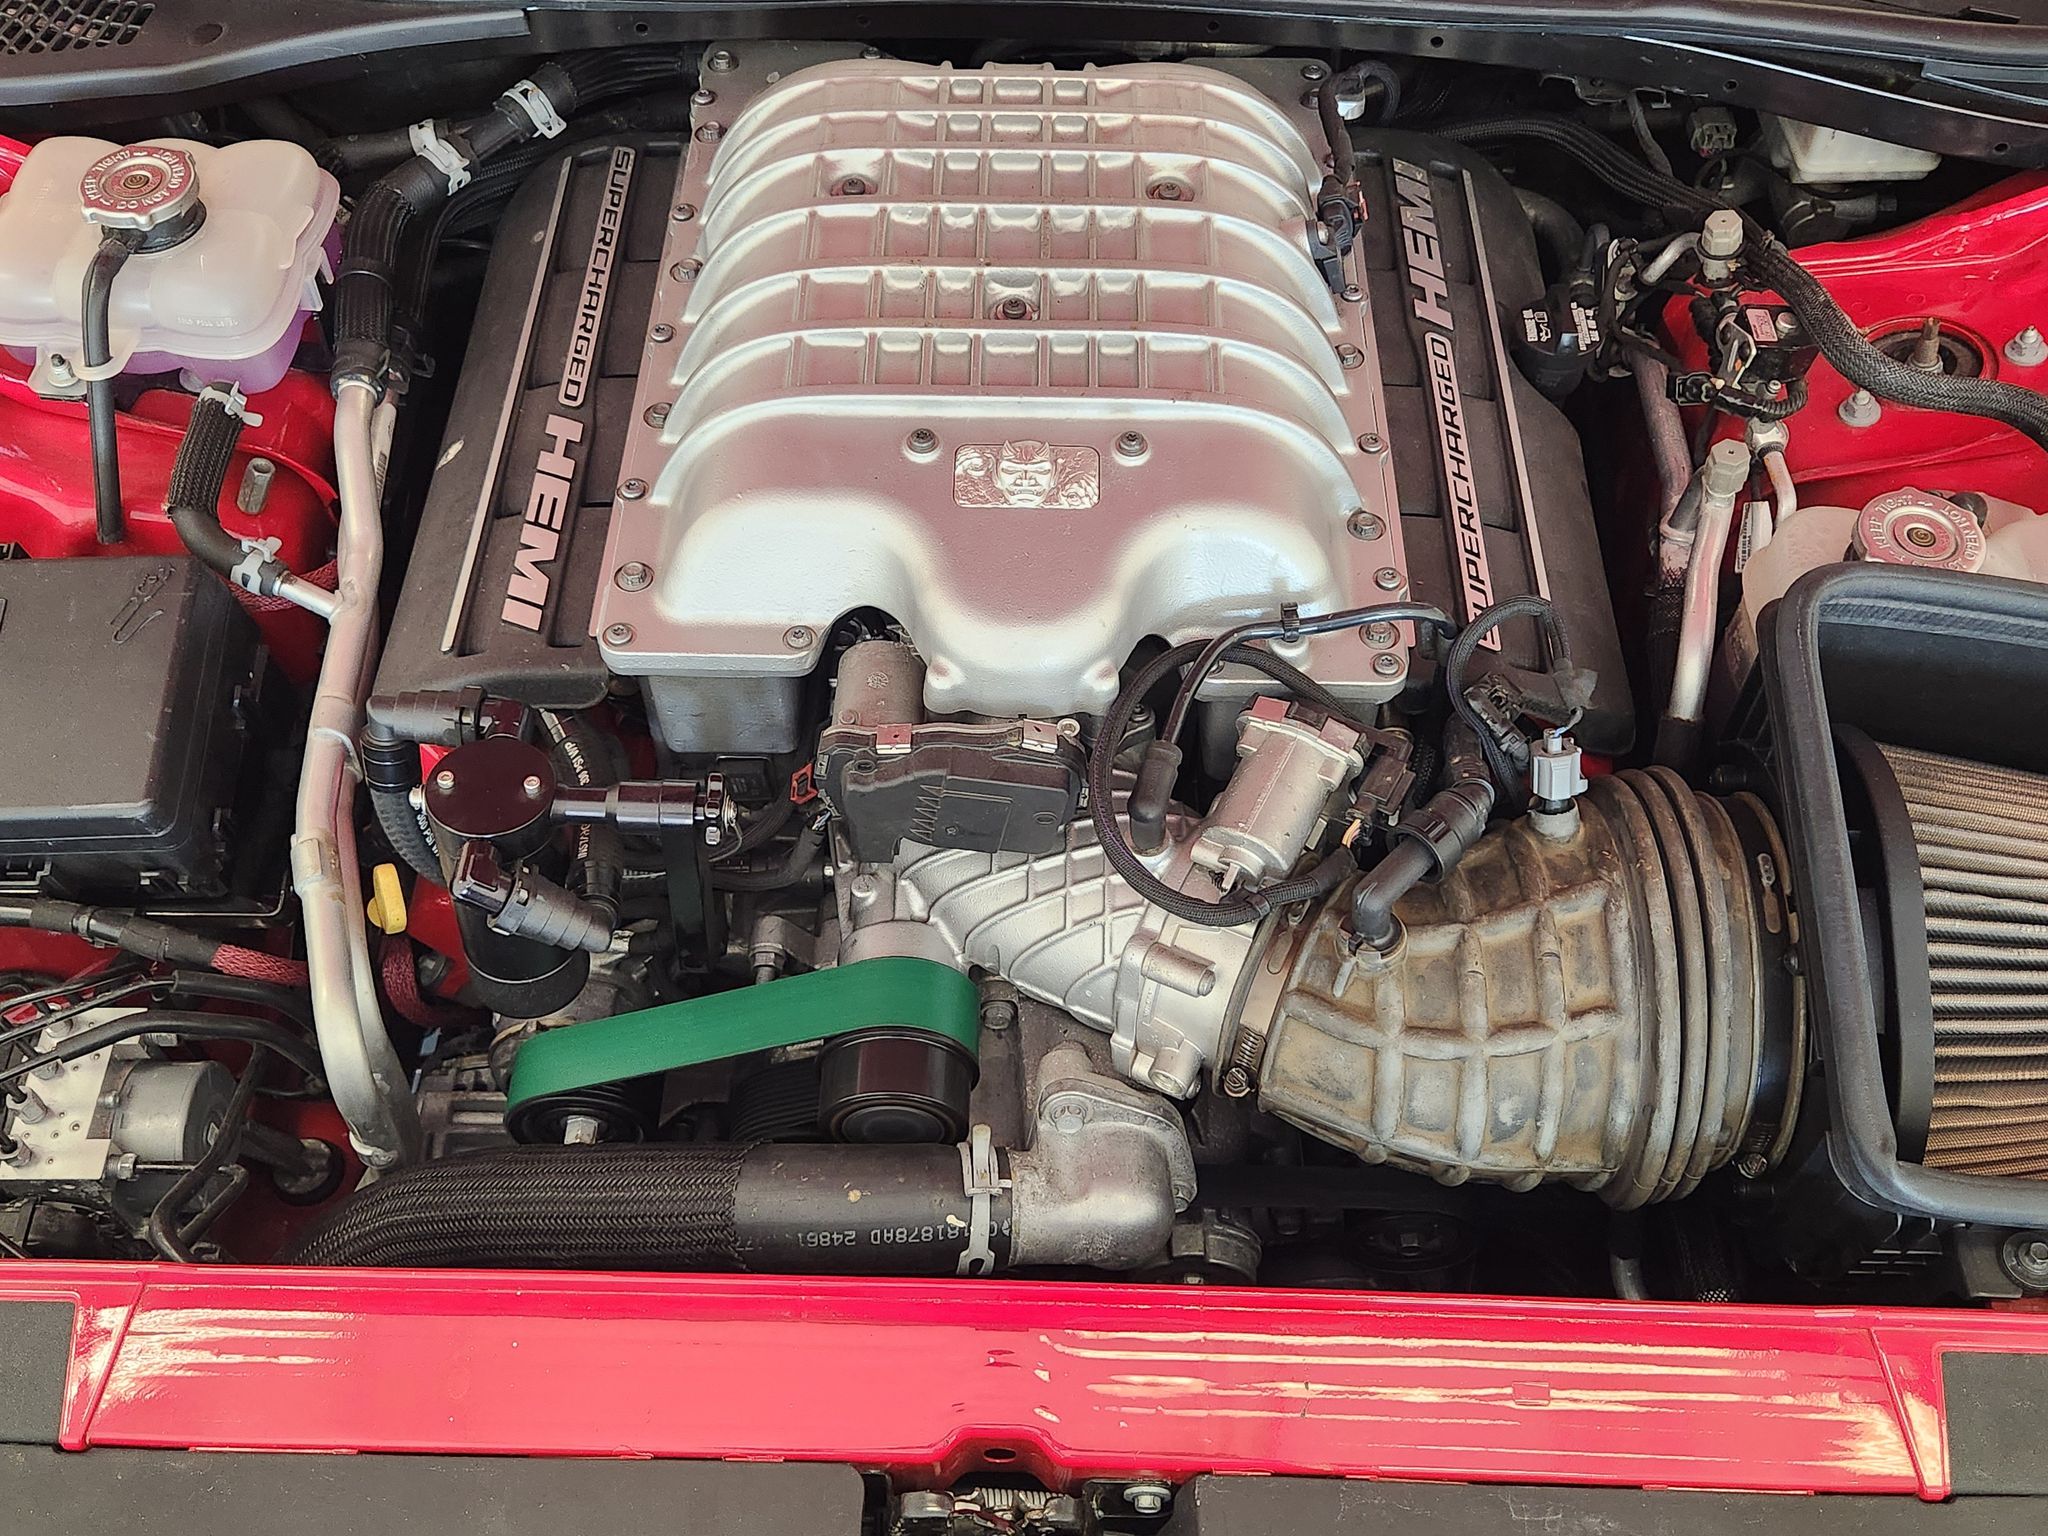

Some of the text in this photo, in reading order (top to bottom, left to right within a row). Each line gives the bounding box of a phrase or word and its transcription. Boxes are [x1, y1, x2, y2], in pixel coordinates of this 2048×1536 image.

[152, 149, 180, 166] HOT
[84, 150, 131, 200] KEEP TIGHT
[168, 163, 185, 189] OPEN
[116, 200, 139, 209] DO
[141, 188, 170, 206] NOT
[501, 147, 634, 632] SUPERCHARGED HEMI
[1393, 157, 1498, 648] UPERCHARGED HEMI
[1868, 494, 1913, 549] KEEP TIGHT
[1939, 505, 1971, 528] HOT
[1963, 528, 1980, 560] OPEN
[564, 741, 580, 760] WP
[571, 755, 585, 773] PSI
[578, 770, 590, 786] 300
[416, 813, 428, 830] 300
[422, 827, 436, 846] PSI
[870, 1219, 998, 1245] 0181878AD
